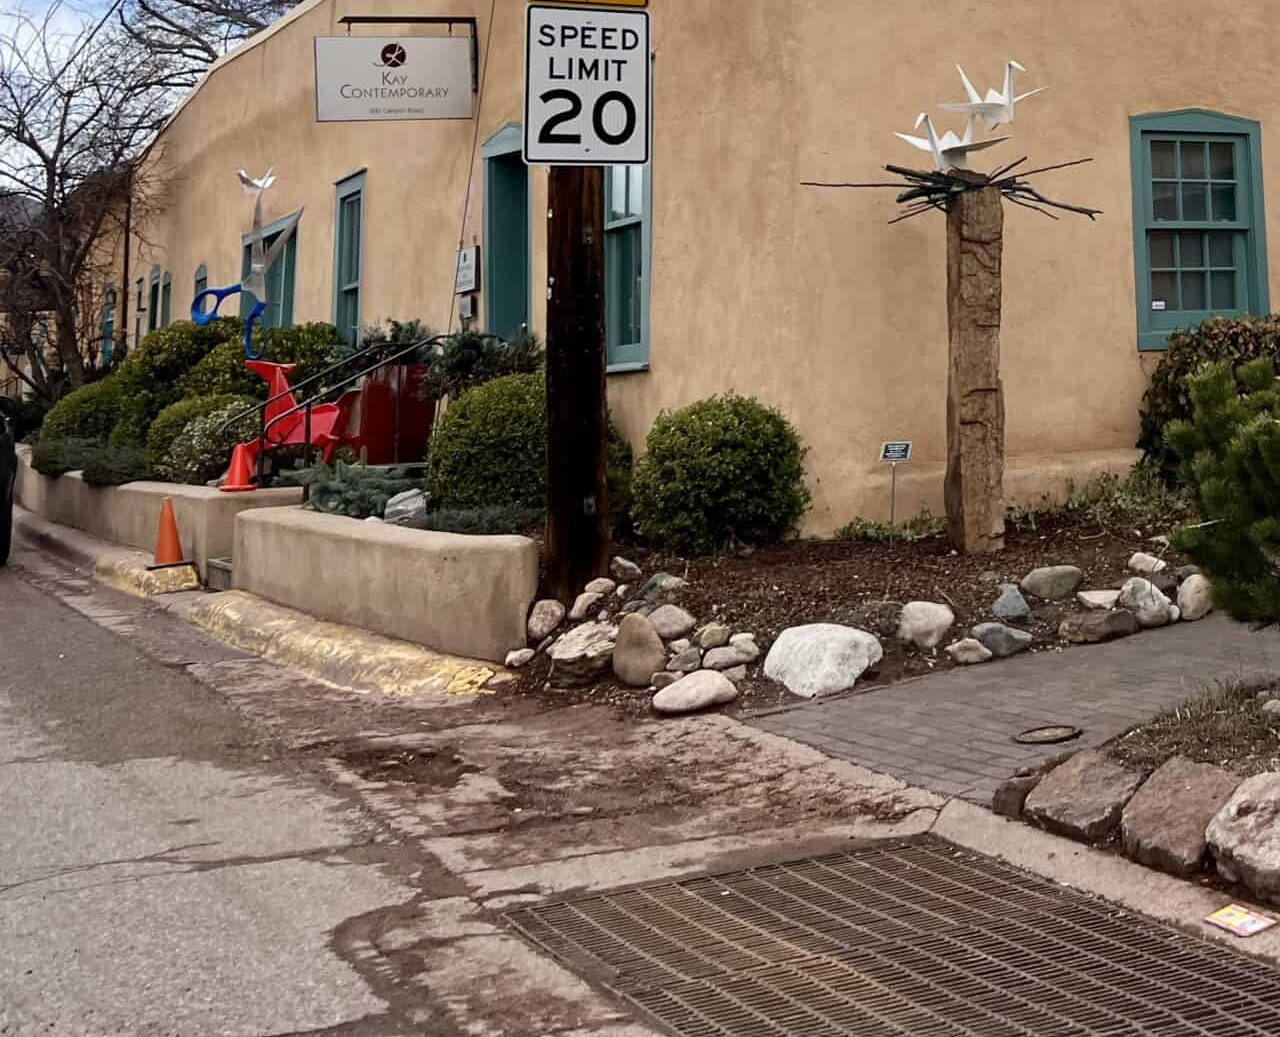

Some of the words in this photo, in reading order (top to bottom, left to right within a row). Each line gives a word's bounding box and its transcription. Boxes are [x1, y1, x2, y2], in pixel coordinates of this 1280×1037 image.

[538, 24, 639, 51] SPEED
[549, 56, 628, 82] LIMIT
[339, 84, 449, 100] CONTEMPORARY
[537, 88, 637, 146] 20
